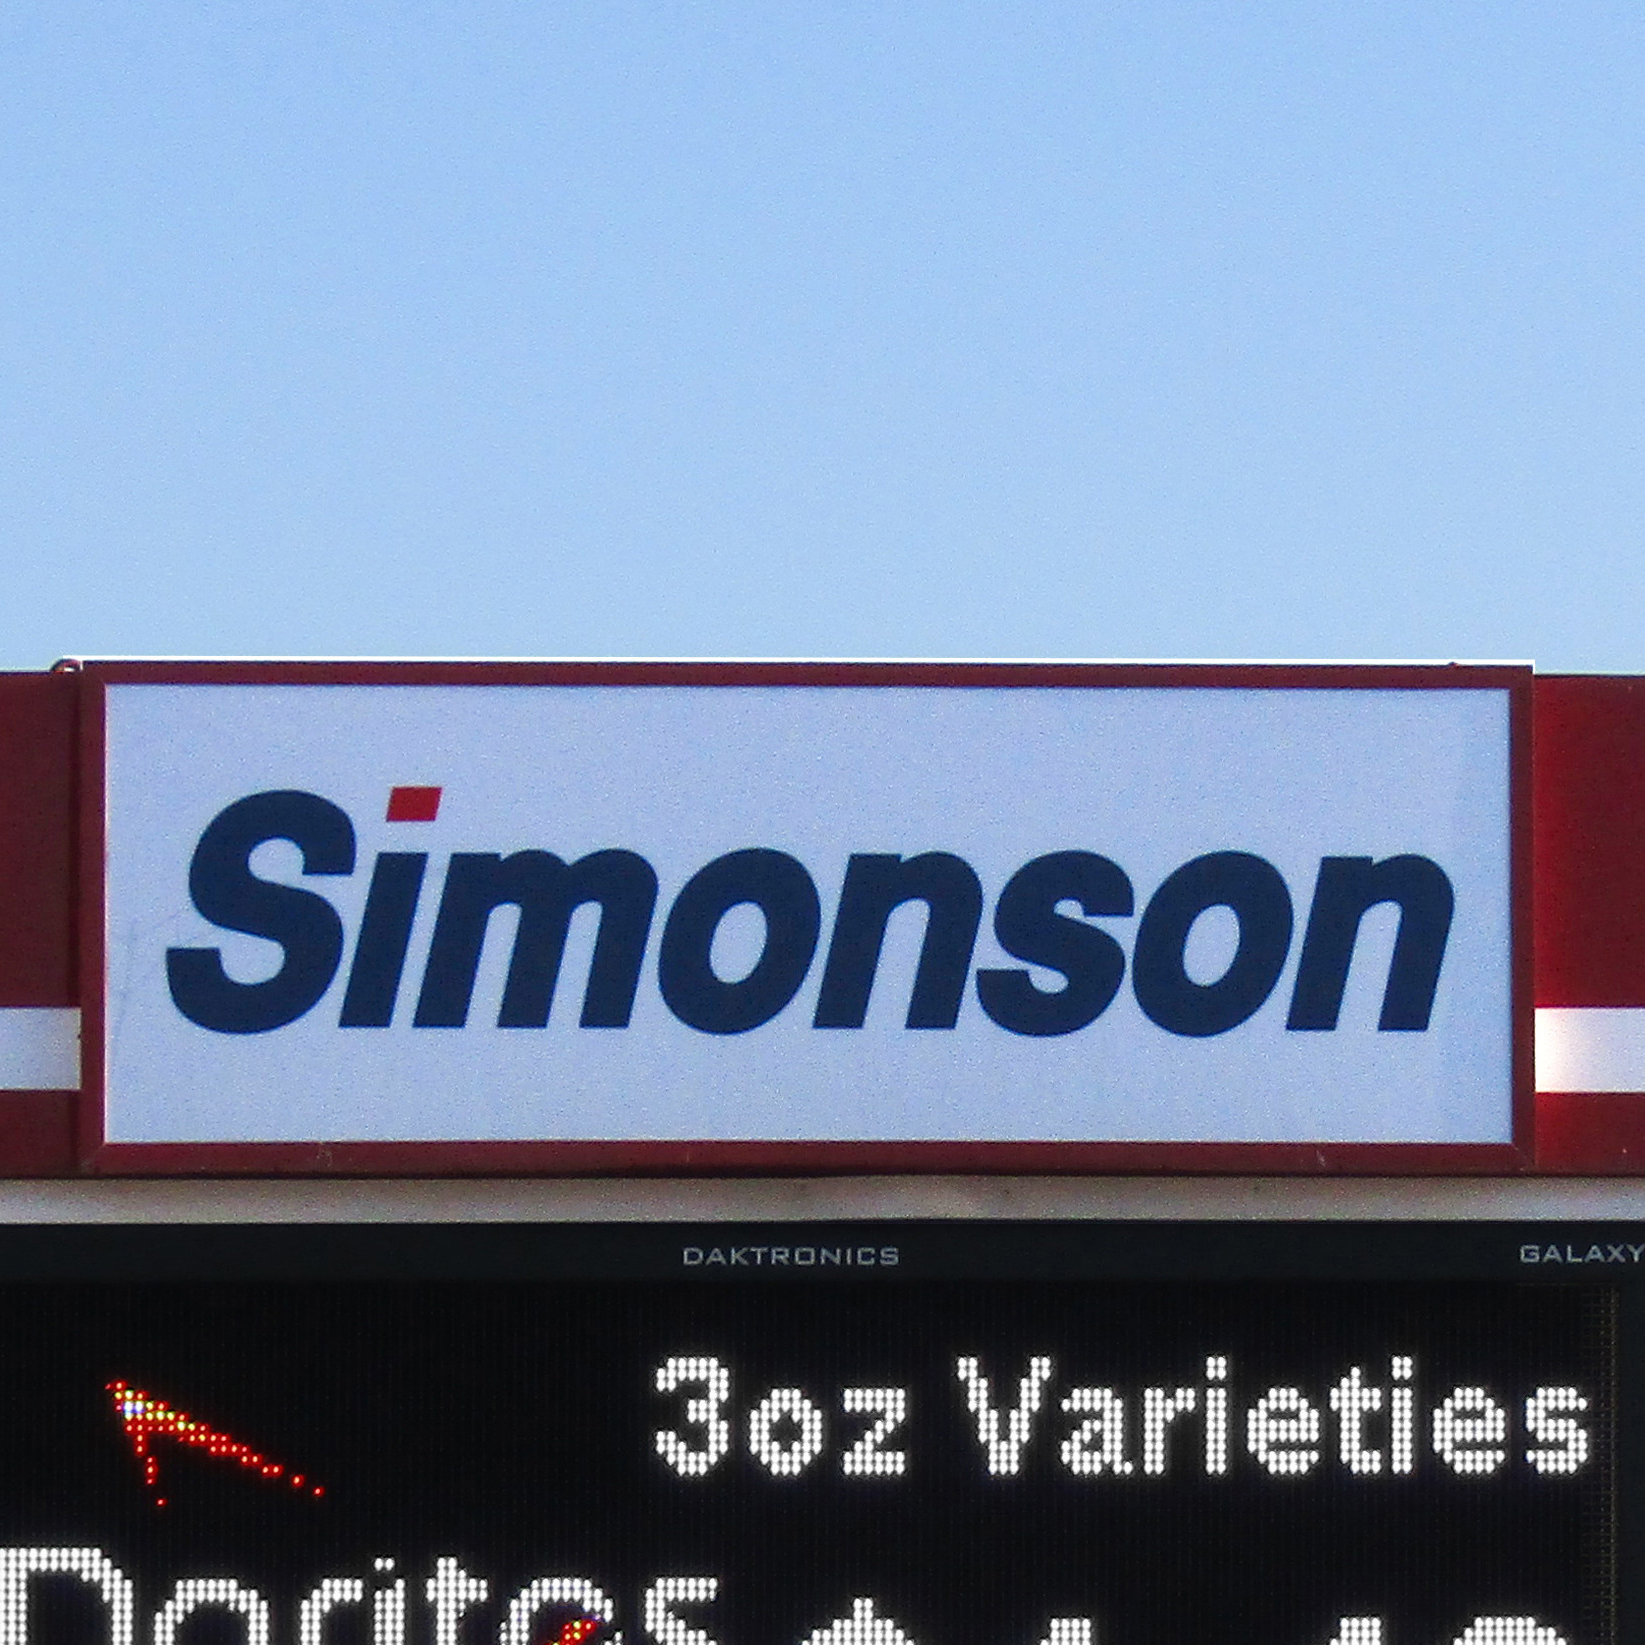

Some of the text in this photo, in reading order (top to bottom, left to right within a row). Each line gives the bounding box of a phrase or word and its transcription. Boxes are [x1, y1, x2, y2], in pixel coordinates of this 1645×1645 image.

[166, 786, 1454, 1037] Simonson
[682, 1246, 900, 1267] DAKTRONICS
[655, 1356, 1588, 1477] 3oz Varieties
